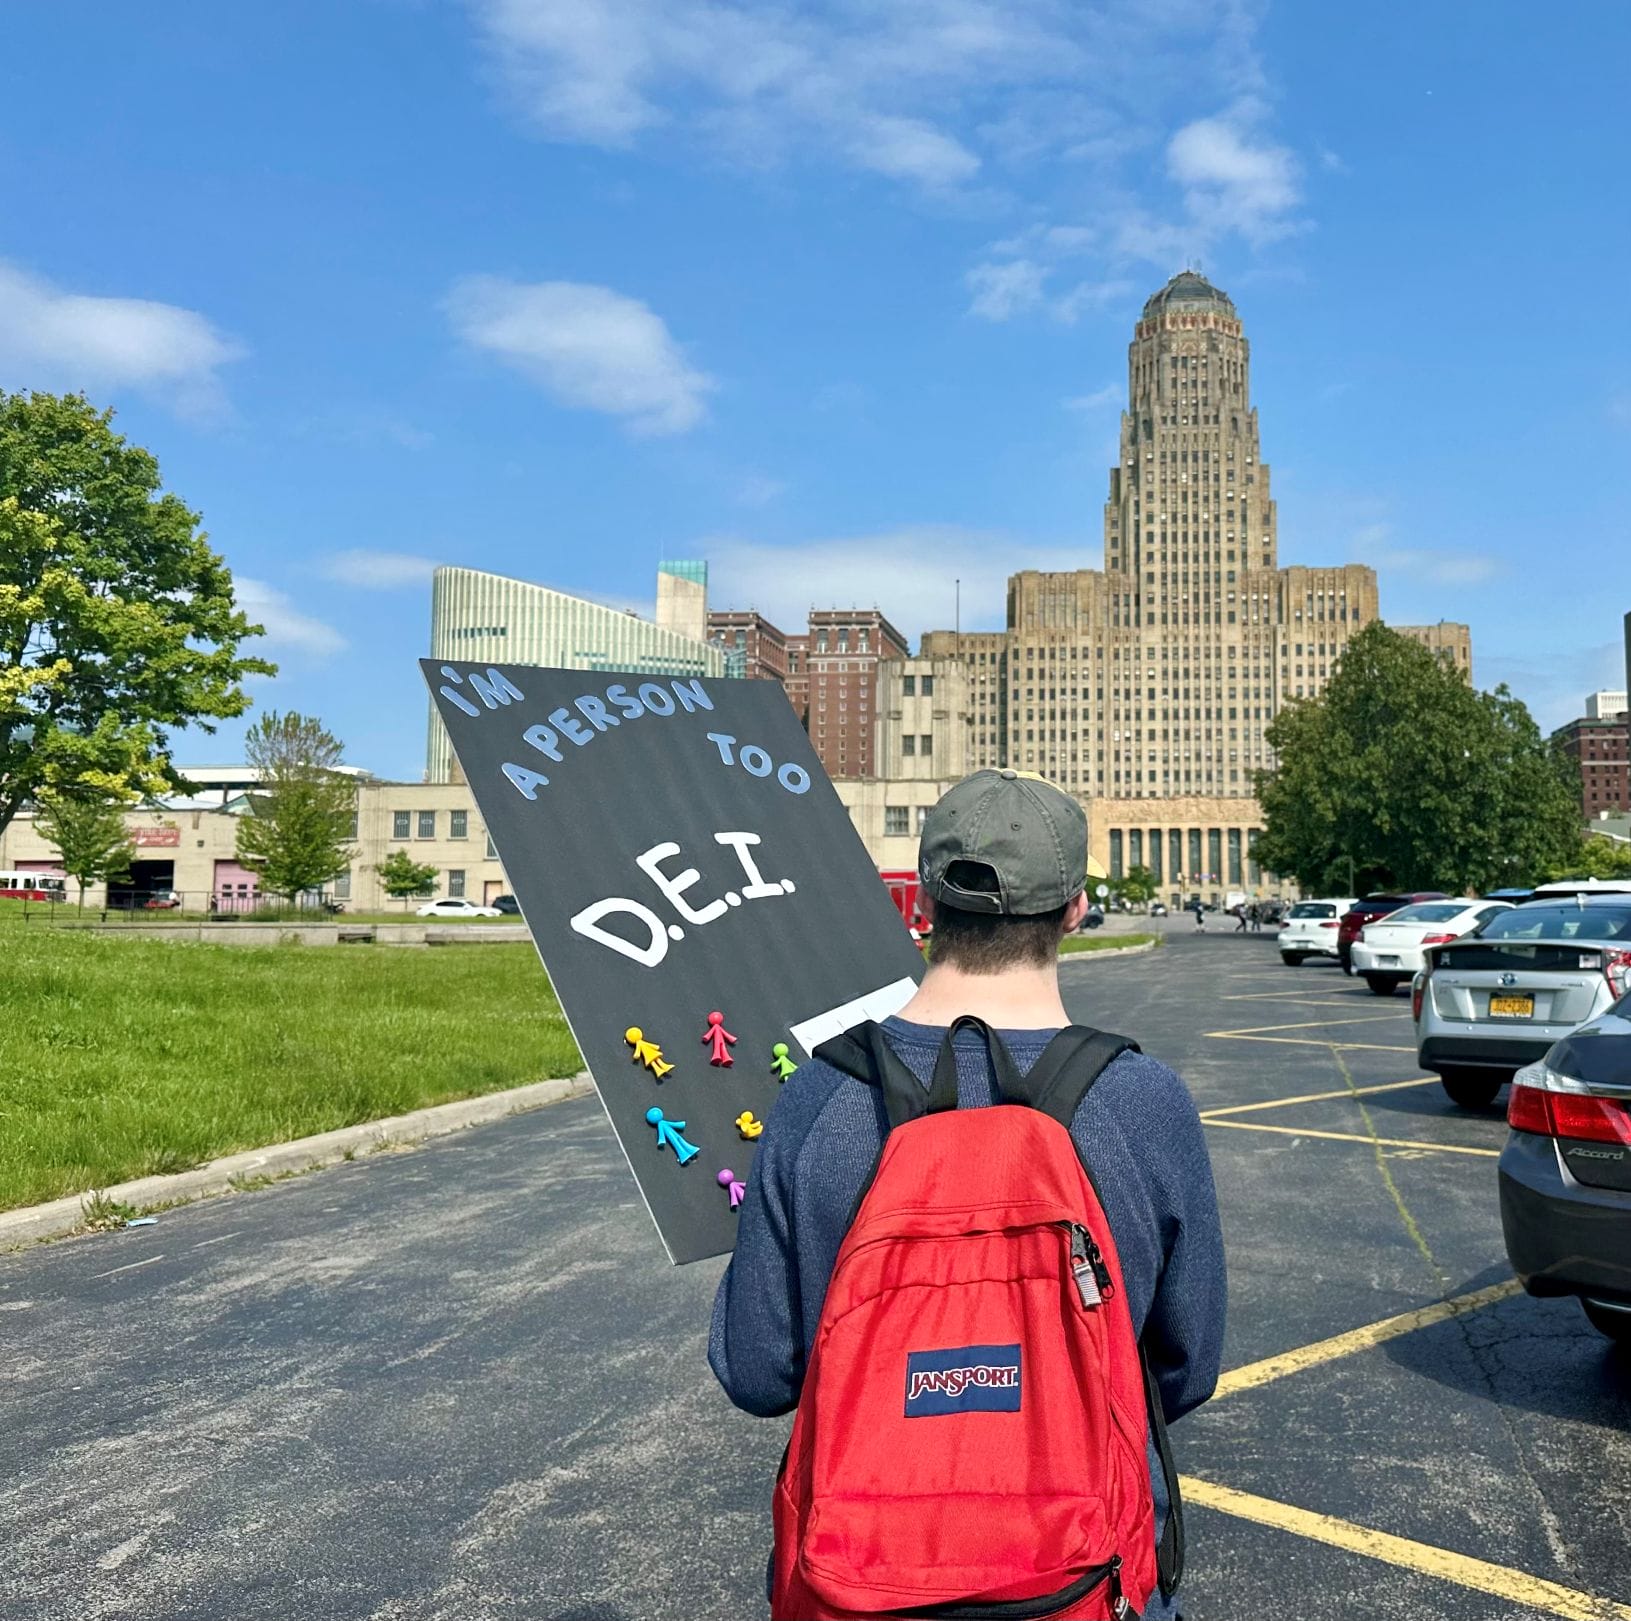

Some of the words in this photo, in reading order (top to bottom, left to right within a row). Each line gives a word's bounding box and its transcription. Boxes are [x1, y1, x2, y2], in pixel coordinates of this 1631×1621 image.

[523, 680, 715, 762] PERSON
[502, 762, 550, 800] A
[706, 732, 811, 794] TOO
[570, 831, 796, 968] D.E.I.
[1566, 1147, 1625, 1160] Accord
[908, 1365, 1018, 1400] JANSPORT
